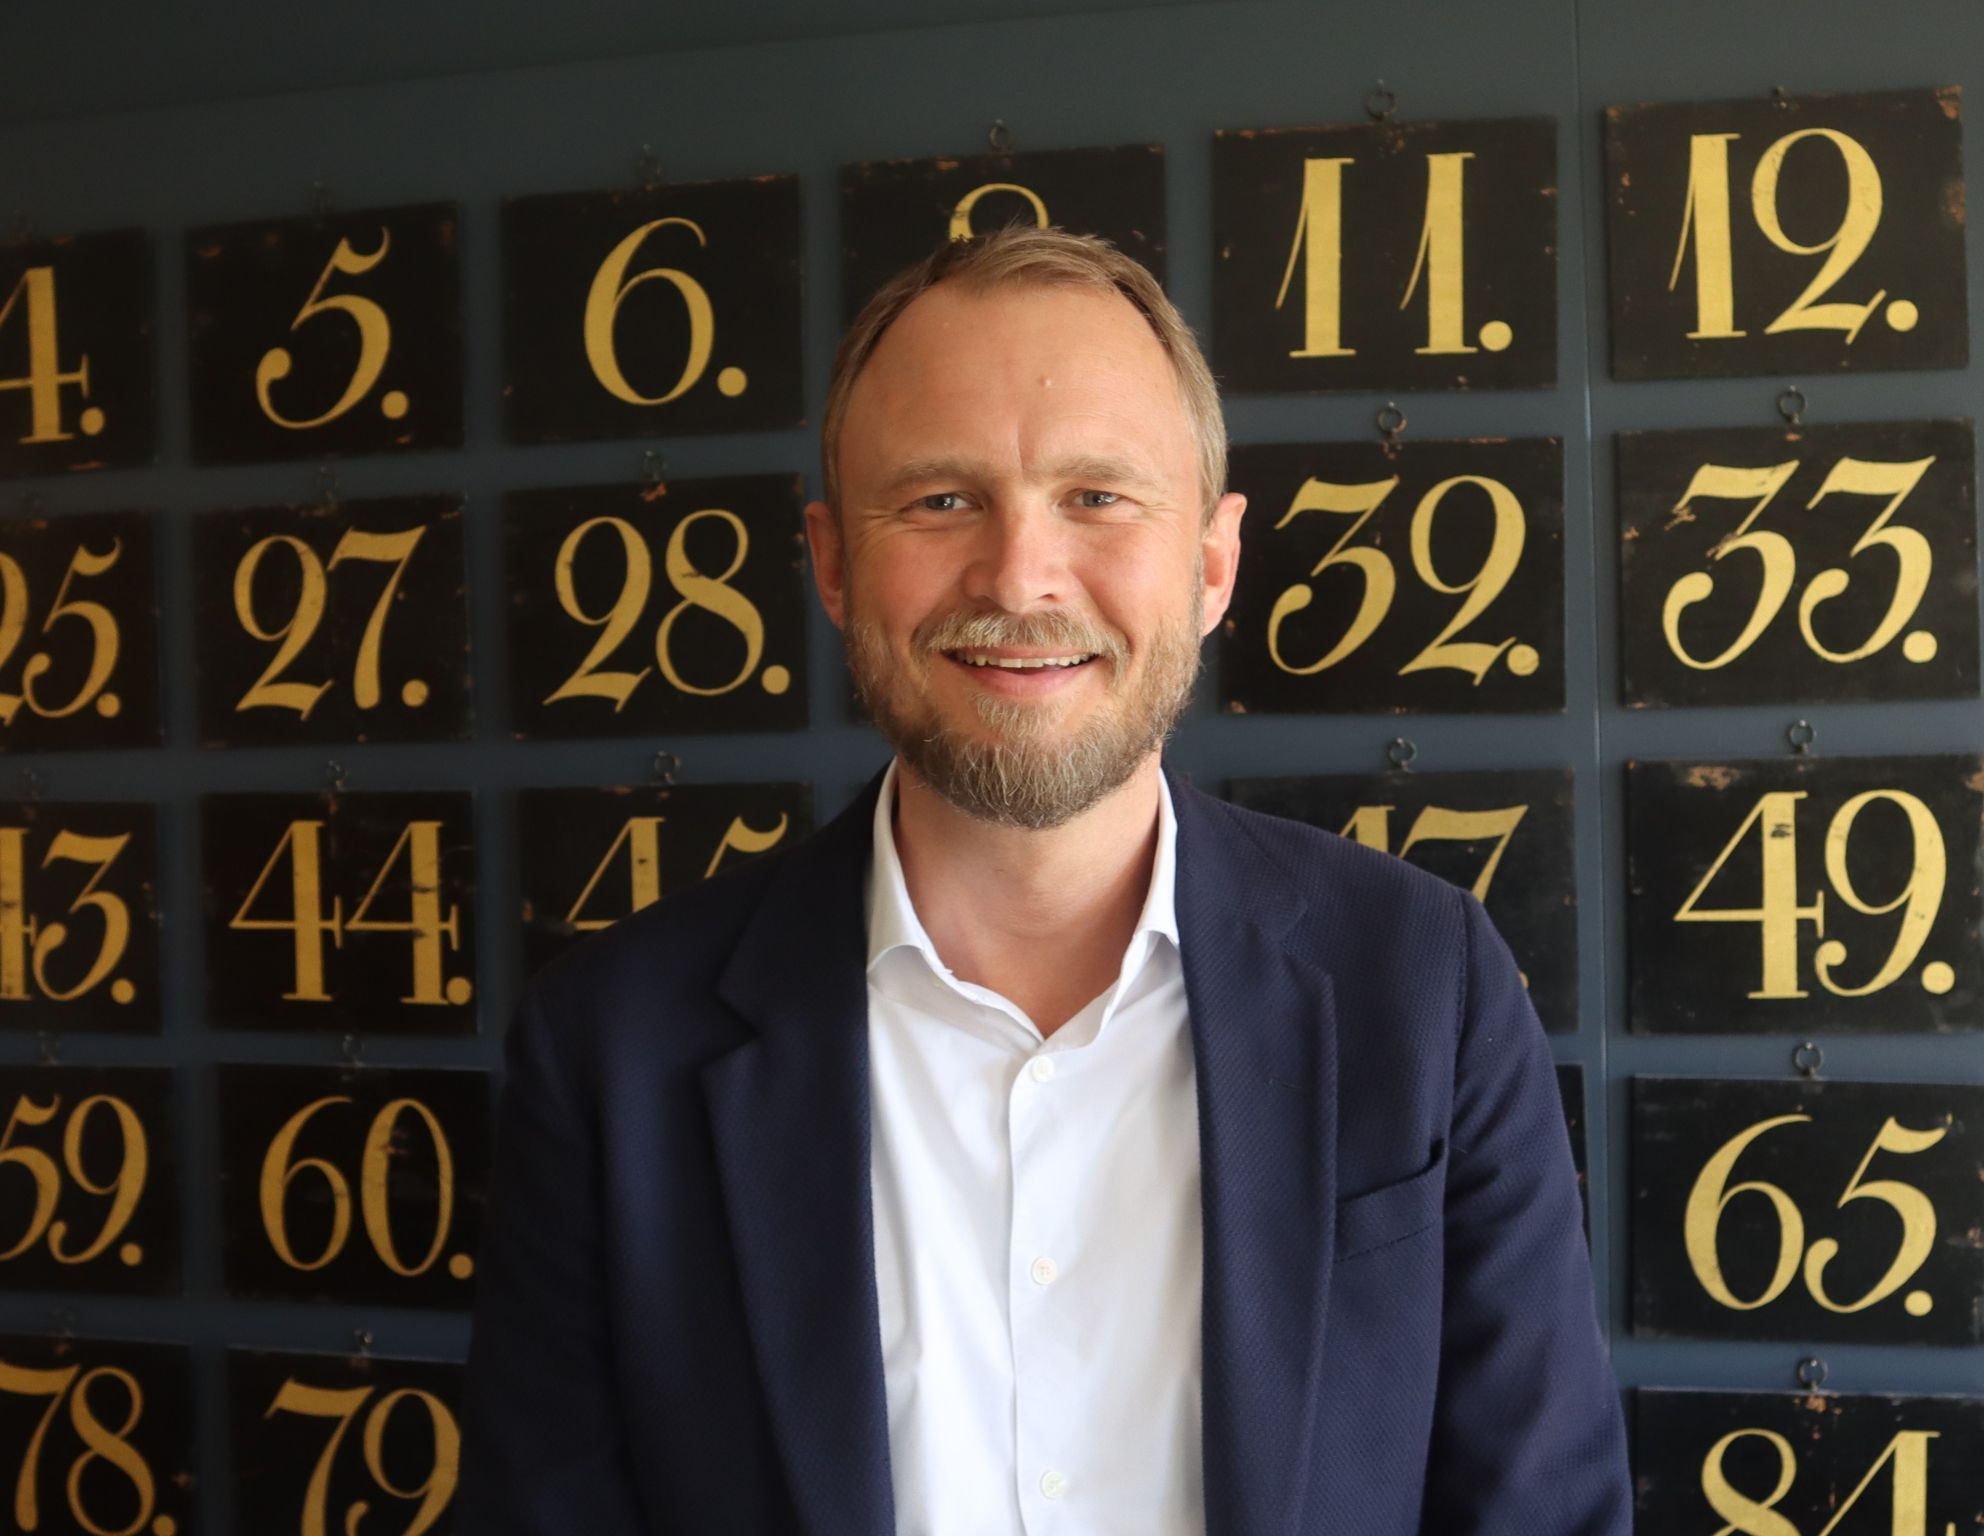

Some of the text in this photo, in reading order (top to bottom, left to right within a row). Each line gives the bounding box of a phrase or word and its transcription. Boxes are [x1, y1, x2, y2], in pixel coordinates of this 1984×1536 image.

[256, 226, 409, 429] 5.
[584, 217, 747, 405] 6.
[1275, 151, 1513, 359] 11.
[1668, 127, 1919, 346] 12.
[0, 266, 105, 443] 4.
[234, 526, 428, 720] 27.
[543, 509, 790, 713] 28.
[1267, 474, 1540, 686] 32.
[1662, 456, 1938, 671] 33.
[229, 820, 471, 1006] 44.
[1673, 789, 1956, 1000] 49.
[260, 1096, 474, 1279] 60.
[1684, 1112, 1954, 1317] 65.
[0, 1360, 177, 1536] 78.
